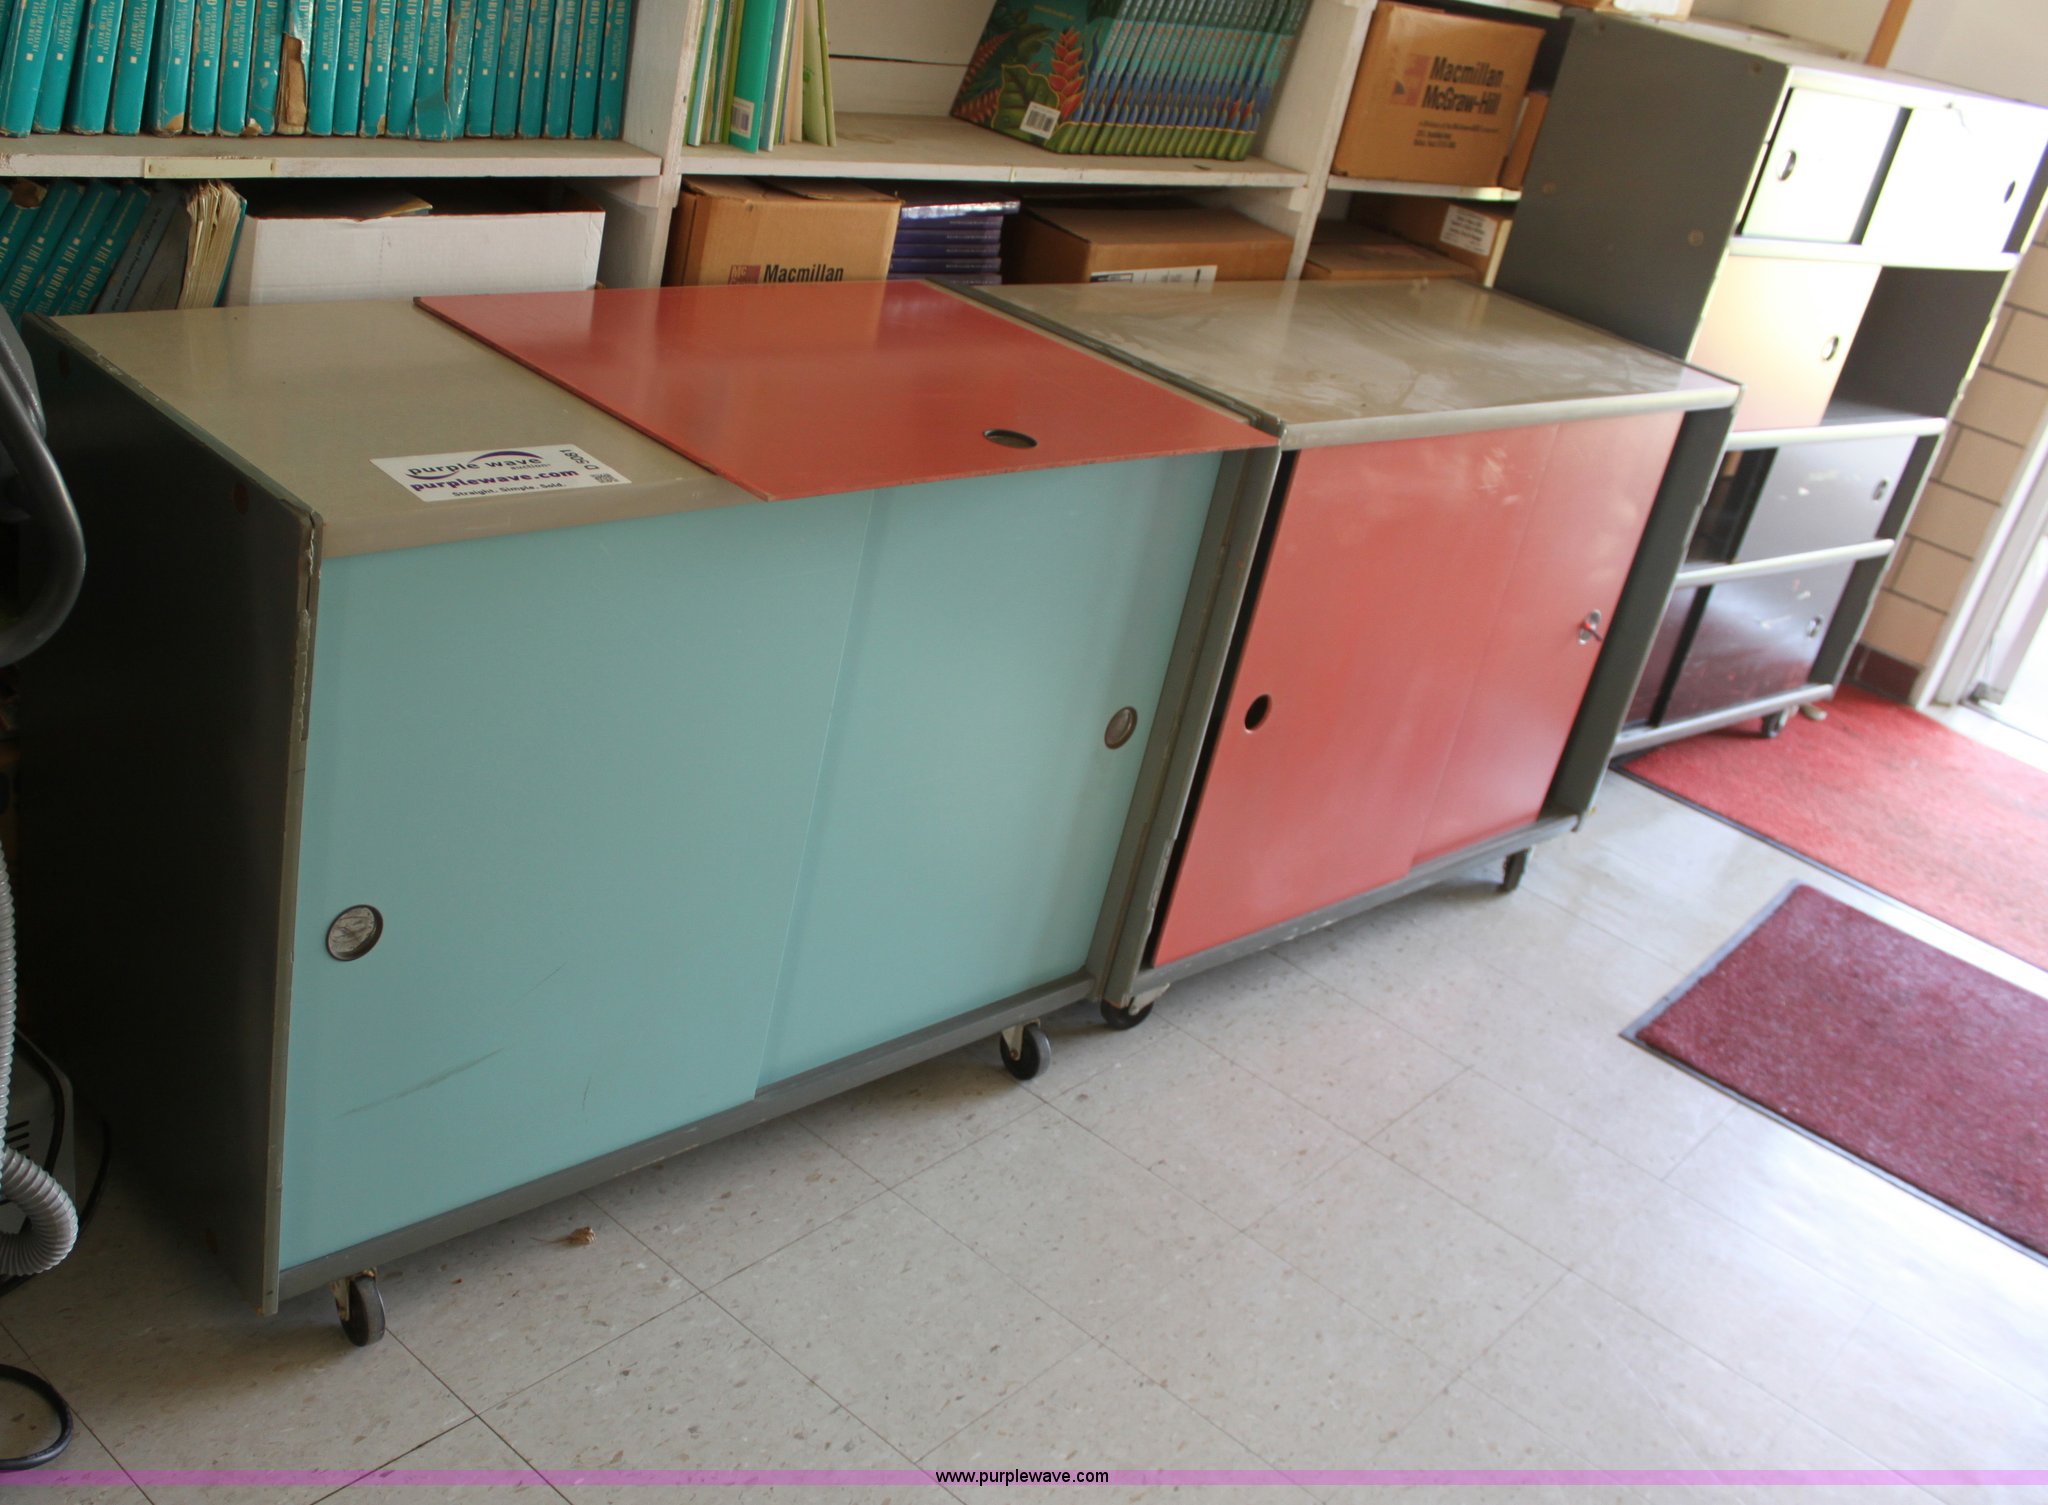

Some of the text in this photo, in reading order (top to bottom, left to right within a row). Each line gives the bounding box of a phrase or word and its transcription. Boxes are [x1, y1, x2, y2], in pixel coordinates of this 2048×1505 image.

[1429, 56, 1504, 87] Macmillan
[1421, 84, 1502, 115] McGraw-Hill
[62, 246, 79, 264] THE
[94, 246, 112, 265] THE
[9, 265, 34, 298] WORLD
[44, 265, 69, 299] WORLD
[77, 266, 102, 298] WORLD
[763, 263, 844, 283] Macmillan
[408, 457, 543, 476] purple wave
[409, 468, 579, 492] purplewave.com
